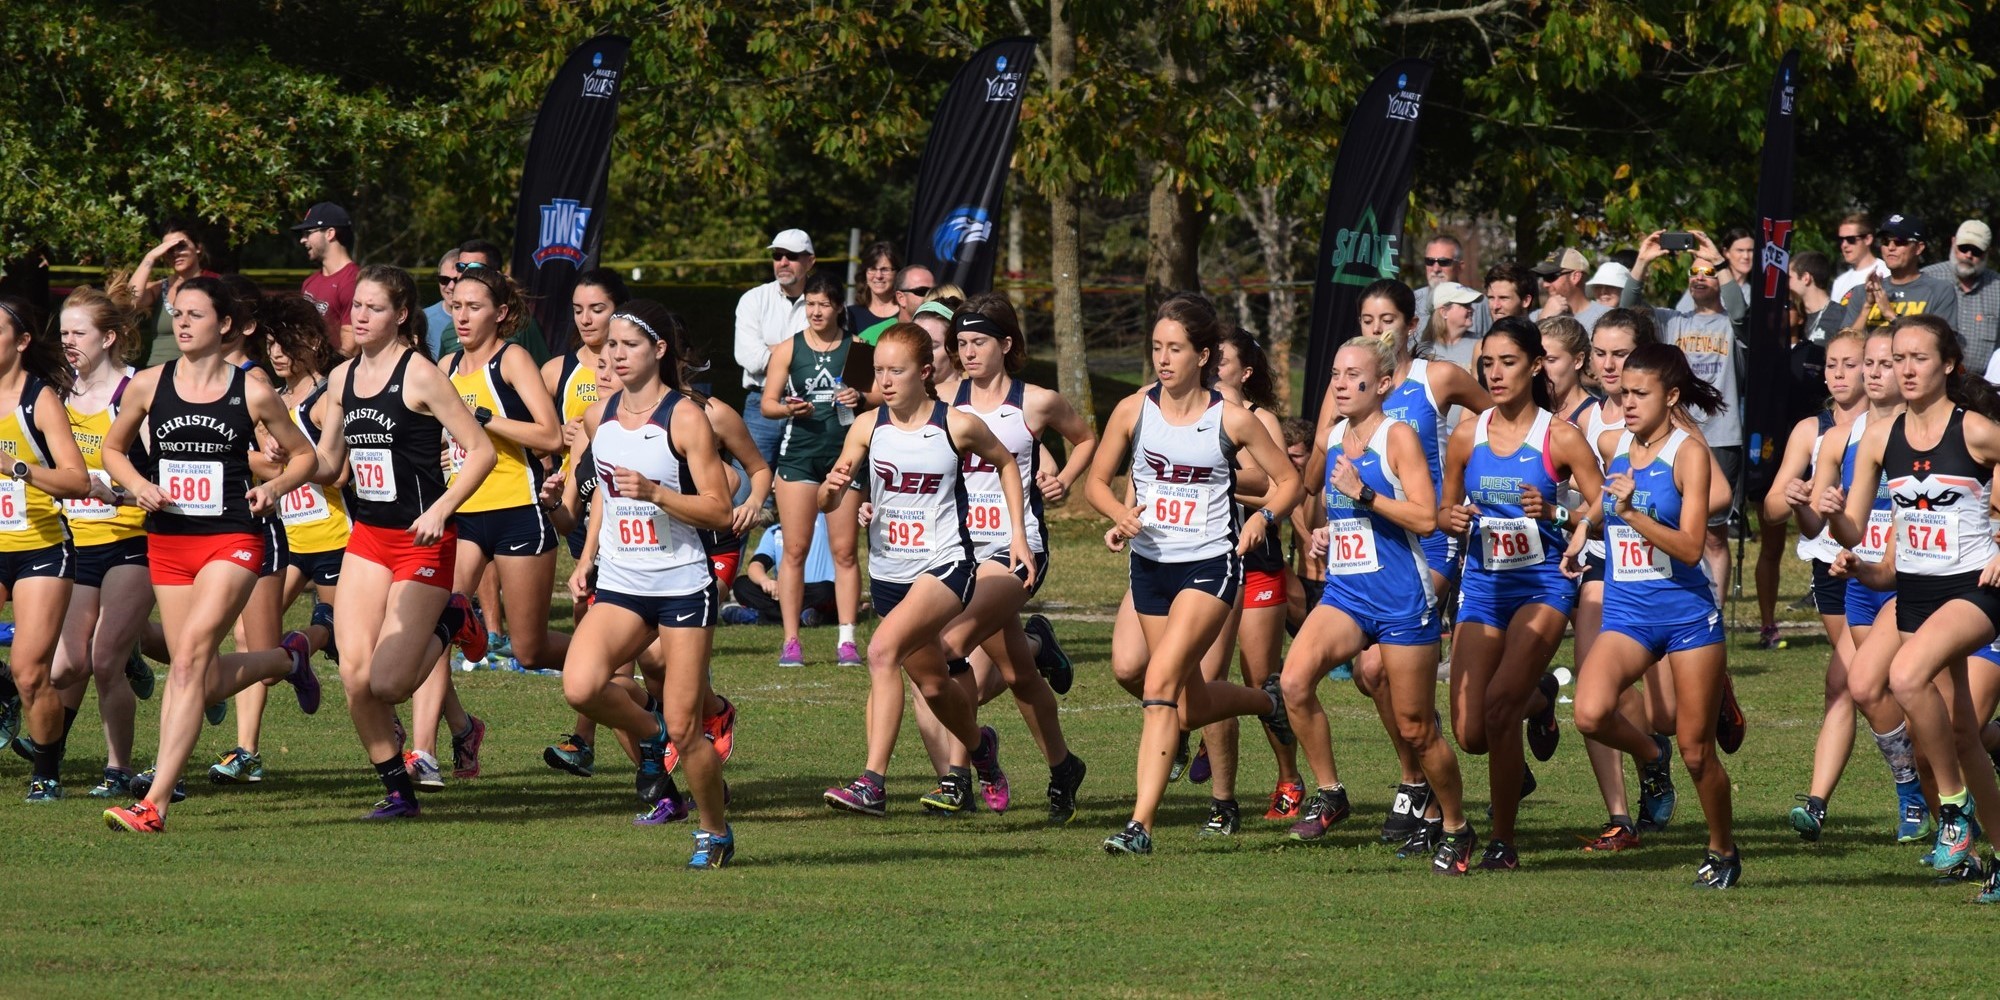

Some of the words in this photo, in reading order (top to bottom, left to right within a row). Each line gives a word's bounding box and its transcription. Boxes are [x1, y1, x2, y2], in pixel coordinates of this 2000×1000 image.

[542, 203, 586, 250] UWG
[1331, 228, 1400, 273] STATE
[156, 414, 238, 442] CHRISTIAN
[343, 408, 396, 431] HRISTIAN
[159, 441, 232, 453] BROTHERS
[356, 464, 384, 489] 679
[875, 462, 944, 495] LEE
[1144, 455, 1214, 483] LEE
[169, 476, 211, 501] 680
[1156, 490, 1200, 499] CONFERENCE
[1480, 476, 1523, 491] WEST
[1471, 491, 1522, 505] FLORID
[1156, 498, 1197, 526] 697
[1904, 517, 1948, 525] CONFERENCE
[619, 519, 659, 545] 691
[888, 521, 925, 547] 692
[1148, 523, 1200, 533] CHAMPIONSHIP
[1908, 525, 1948, 552] 674
[1334, 533, 1367, 561] 762
[1489, 532, 1530, 557] 768
[1619, 541, 1655, 567] 767
[1904, 549, 1953, 560] CHAMPIONSHIP
[1487, 553, 1539, 564] CHAMPIONSHIP
